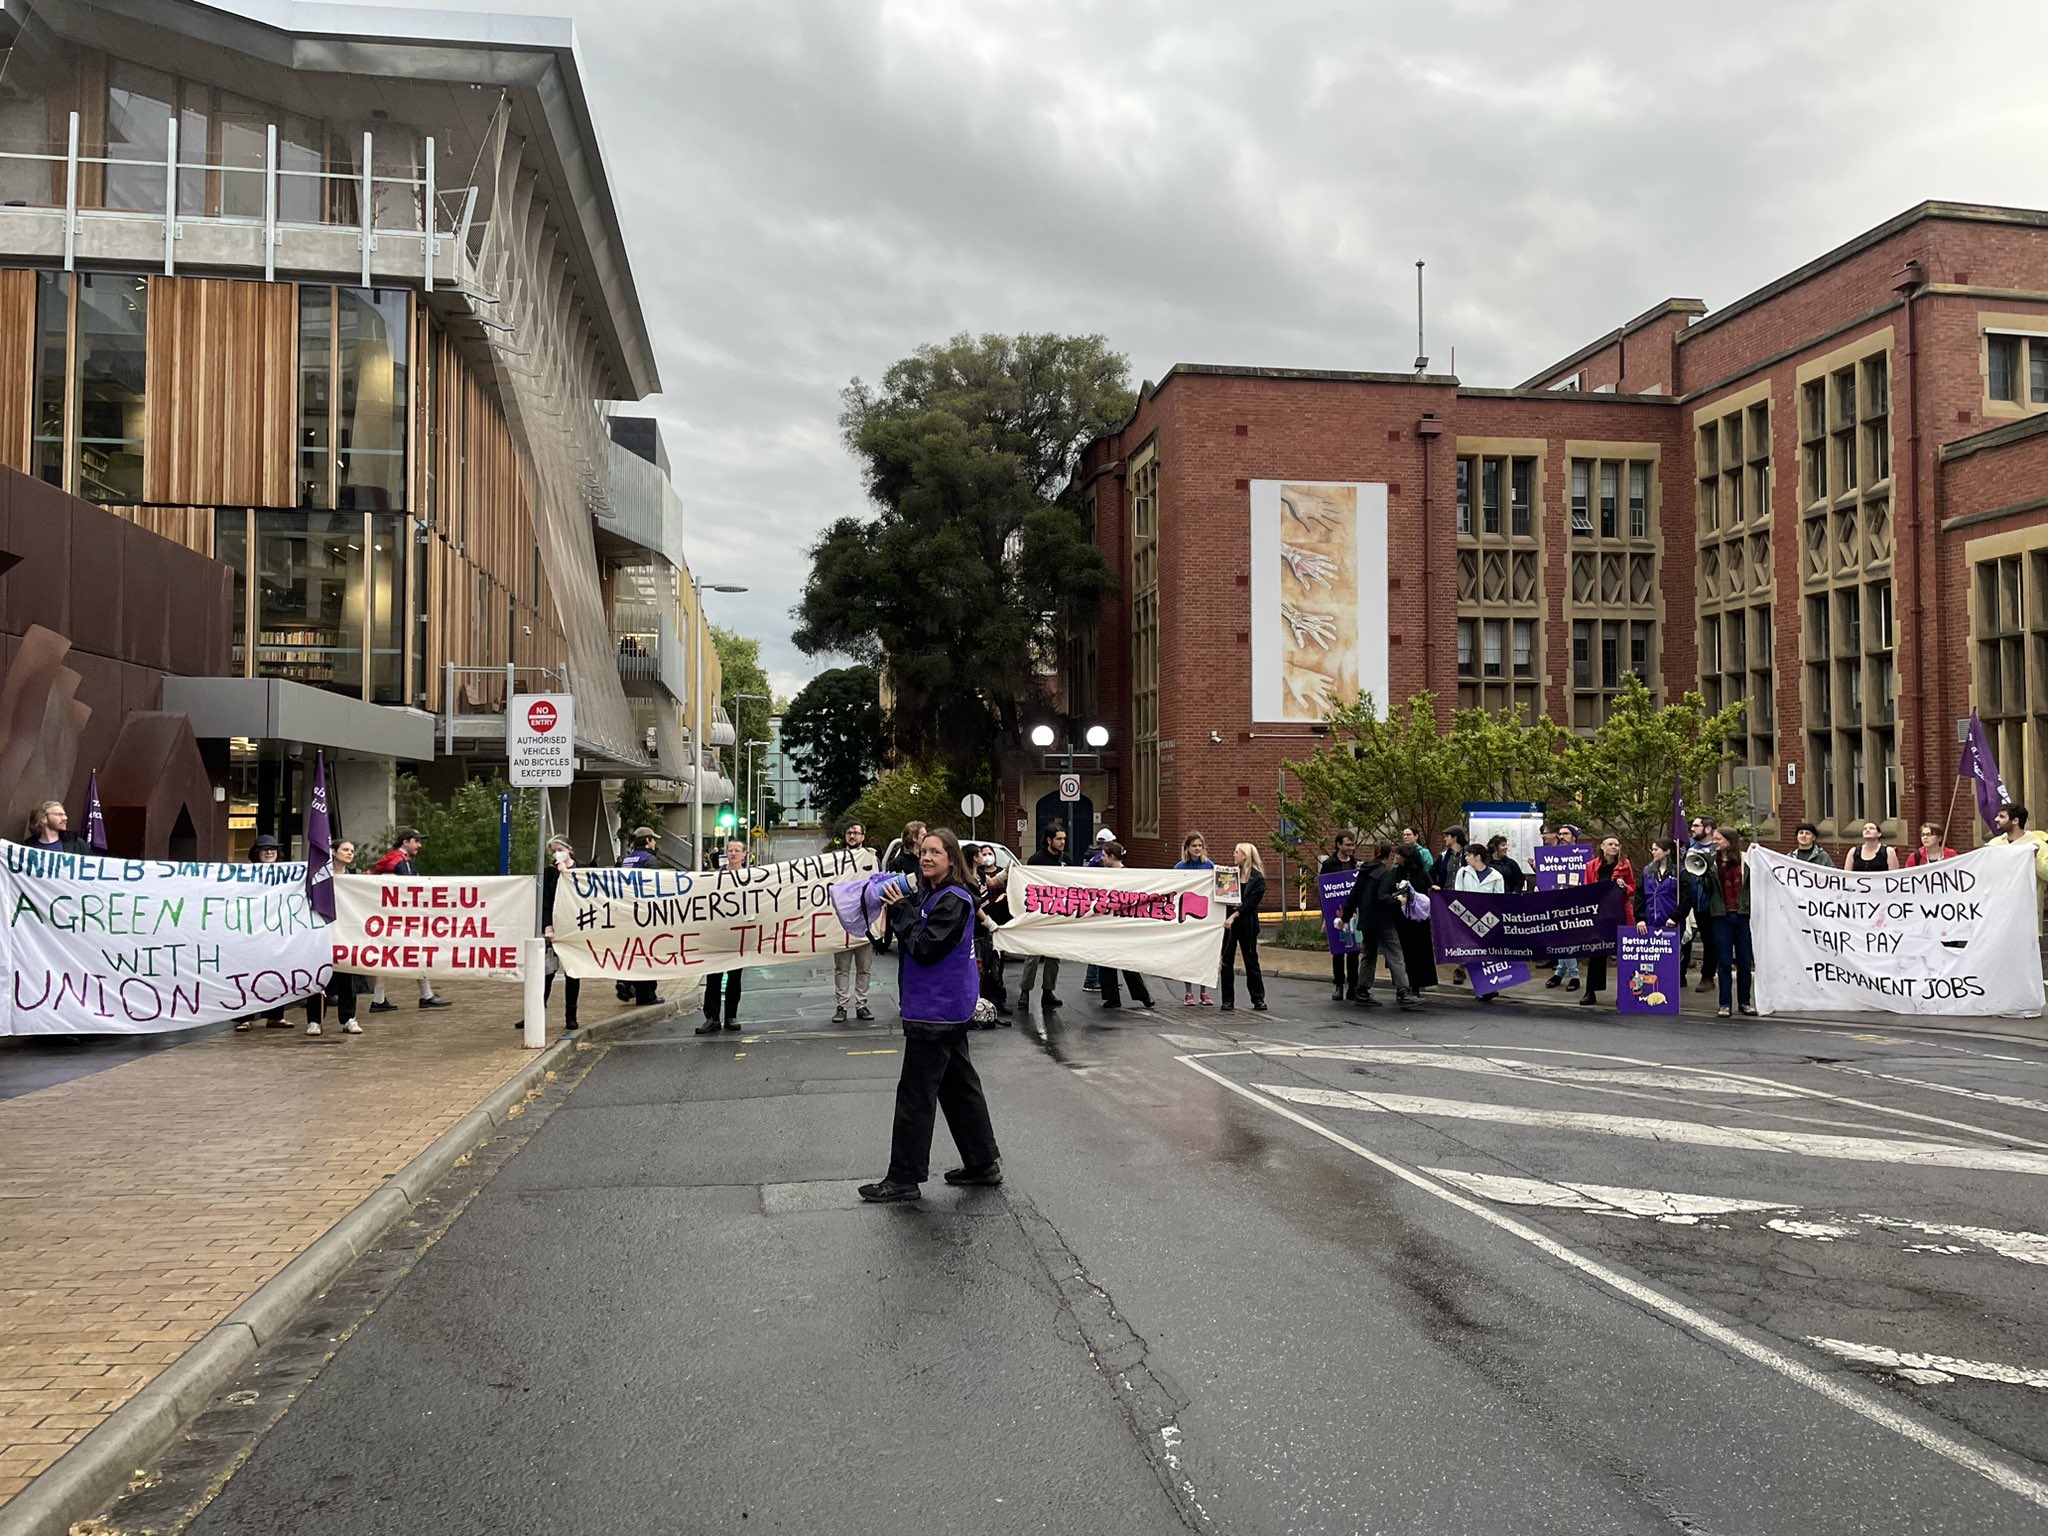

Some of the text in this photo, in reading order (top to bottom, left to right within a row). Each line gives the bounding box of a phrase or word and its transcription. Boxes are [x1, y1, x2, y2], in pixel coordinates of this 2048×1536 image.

[536, 706, 549, 714] NO
[531, 719, 554, 727] ENTRY
[517, 736, 567, 745] AUTHORISED
[523, 747, 561, 756] VEHICLES
[513, 758, 570, 767] AND BICYCLES
[521, 769, 562, 778] EXCEPTED
[1065, 782, 1076, 793] 10
[1540, 864, 1566, 872] Better
[1544, 856, 1559, 864] We
[217, 863, 306, 886] DEMAND
[1772, 865, 1976, 894] CASUALS DEMAND
[573, 869, 693, 900] UNIMELB
[1025, 884, 1109, 900] STUDENTS
[1323, 882, 1344, 891] Want
[381, 886, 486, 909] N.T.E.U.
[49, 892, 184, 935] GREEN
[576, 903, 615, 931] #1
[633, 889, 781, 928] UNIVERSITY
[1024, 896, 1092, 918] STAFF
[1502, 904, 1599, 923] National Tertiary
[1887, 902, 1914, 919] OF
[1920, 902, 1983, 922] WORK
[364, 915, 495, 938] OFFICIAL
[1503, 917, 1594, 935] Education Union
[586, 933, 704, 972] WAGE
[1445, 948, 1487, 956] Melbourne
[1504, 948, 1533, 956] Branch
[1546, 941, 1615, 954] Stronger together
[1635, 945, 1672, 953] students
[1866, 933, 1903, 954] PAY
[102, 944, 220, 977] WITH
[332, 945, 517, 968] PICKET LINE
[1482, 961, 1512, 976] NTEU.
[14, 969, 201, 1022] UNION
[1922, 976, 1985, 999] JOBS
